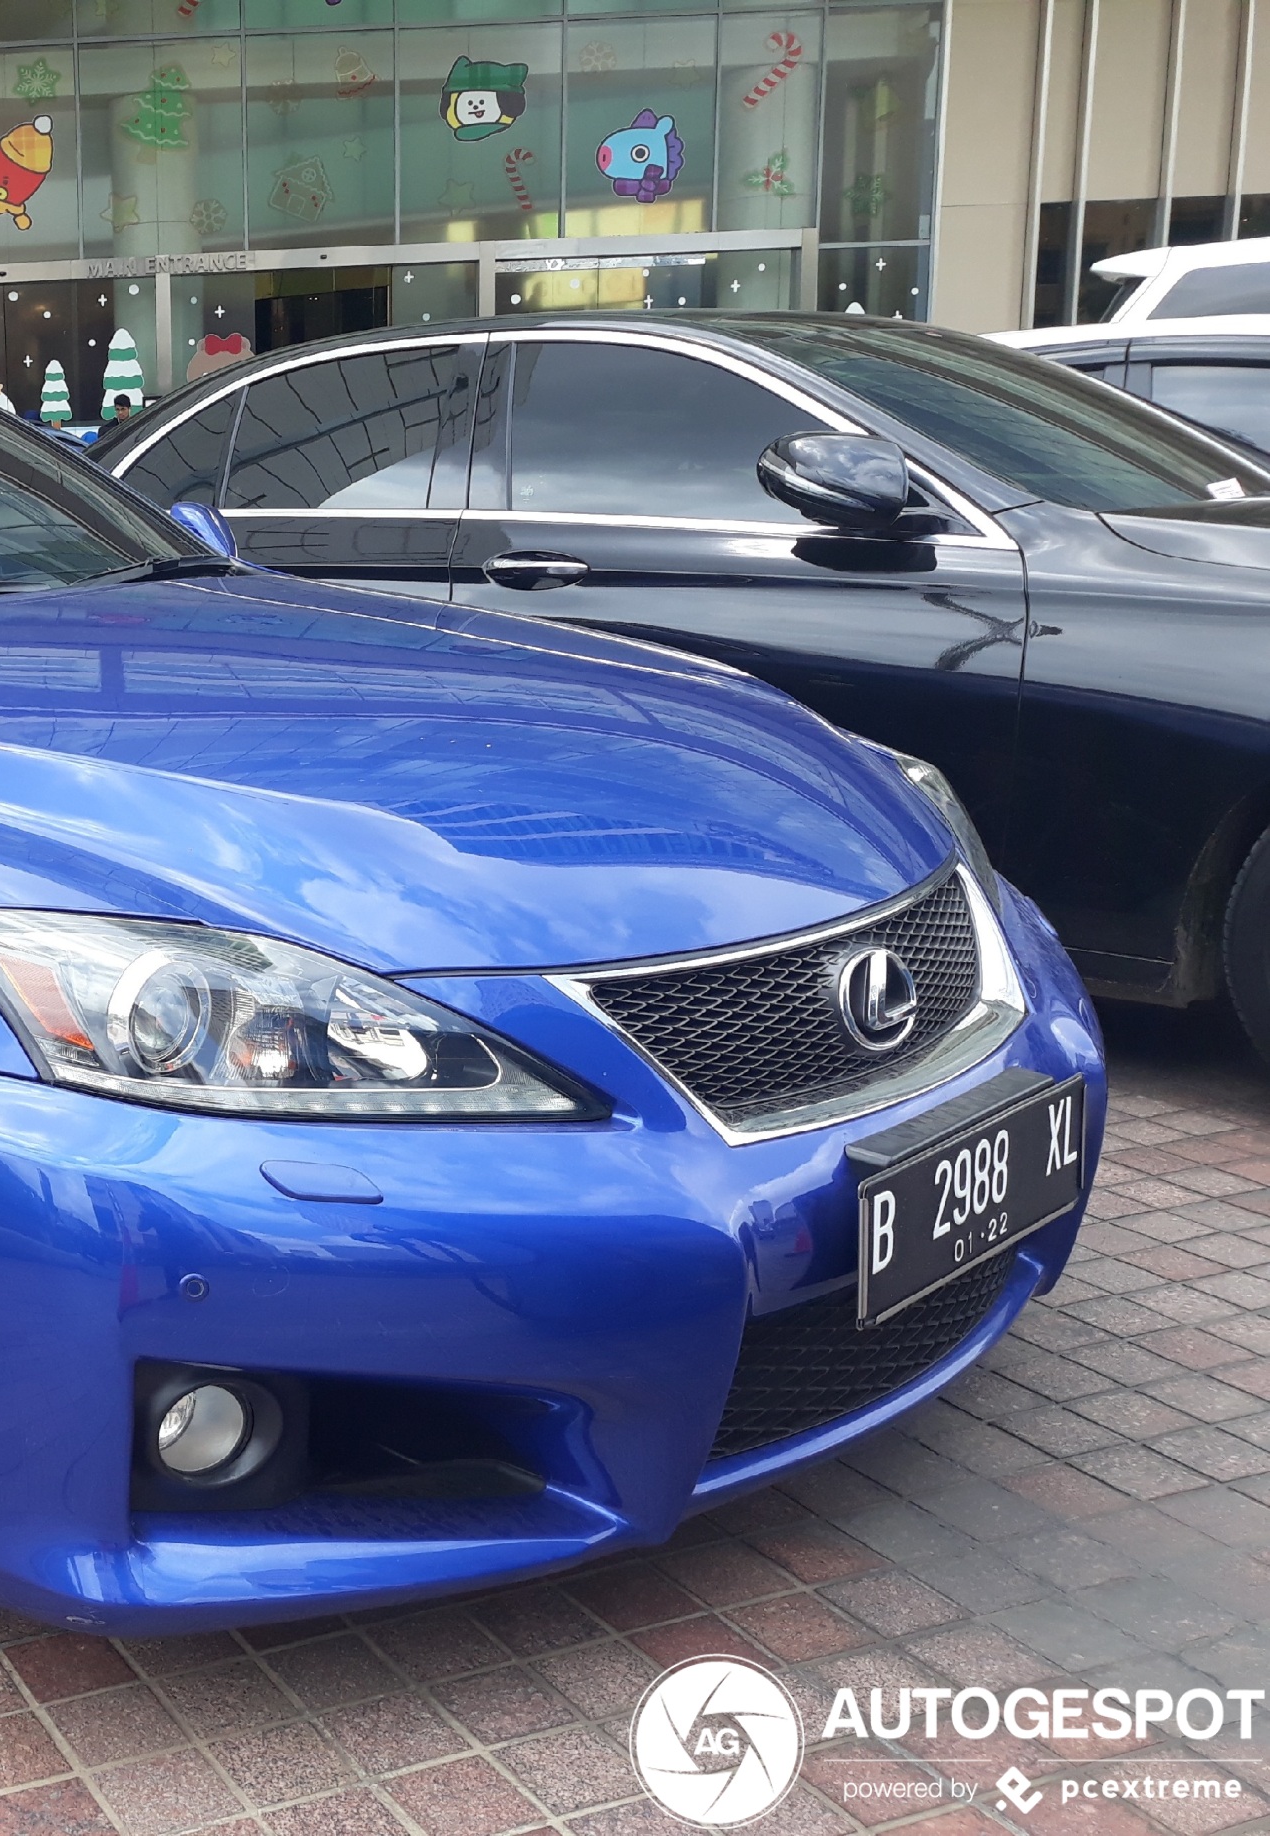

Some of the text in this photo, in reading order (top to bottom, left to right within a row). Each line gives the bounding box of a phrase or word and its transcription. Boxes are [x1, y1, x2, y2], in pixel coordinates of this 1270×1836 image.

[86, 254, 247, 278] MAIN ENTRANCE
[872, 1096, 1078, 1274] B 2988 XL
